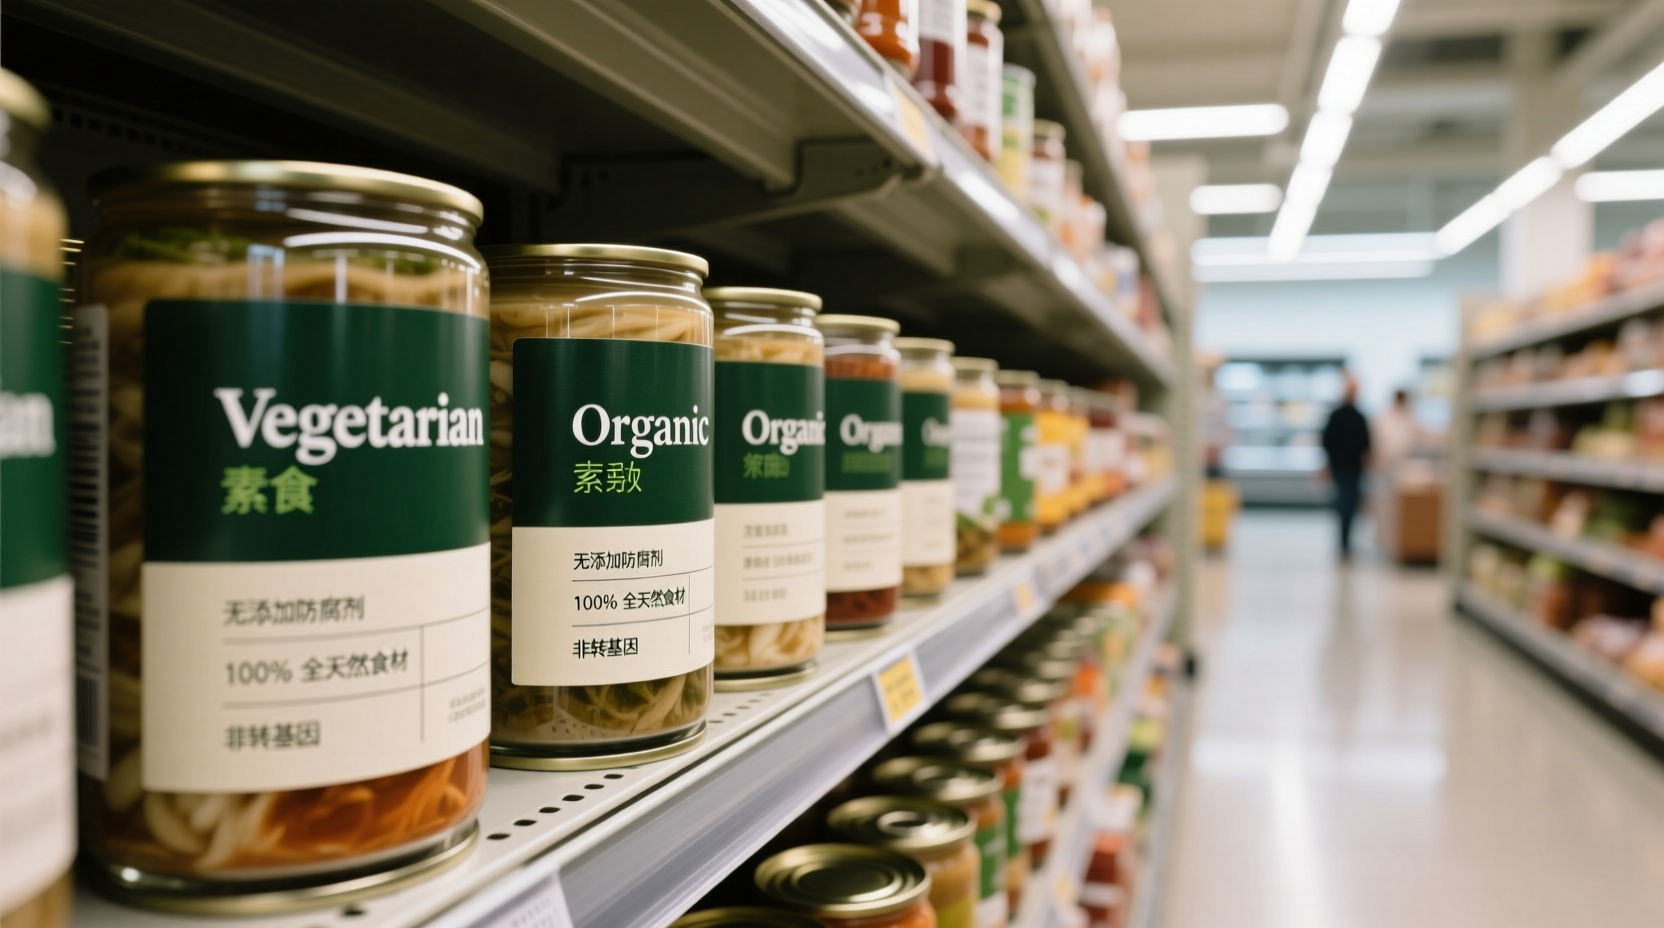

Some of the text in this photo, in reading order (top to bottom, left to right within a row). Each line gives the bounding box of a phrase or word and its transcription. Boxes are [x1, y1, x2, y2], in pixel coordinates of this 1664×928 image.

[214, 387, 484, 465] Vegetarian
[572, 404, 709, 458] Organic
[220, 465, 318, 514] 素食
[223, 595, 365, 627] 无添加防腐剂
[574, 594, 618, 611] 100%
[572, 637, 639, 659] 非转基因
[225, 649, 408, 685] 100% 全天然食材
[224, 721, 321, 751] 非转基因
